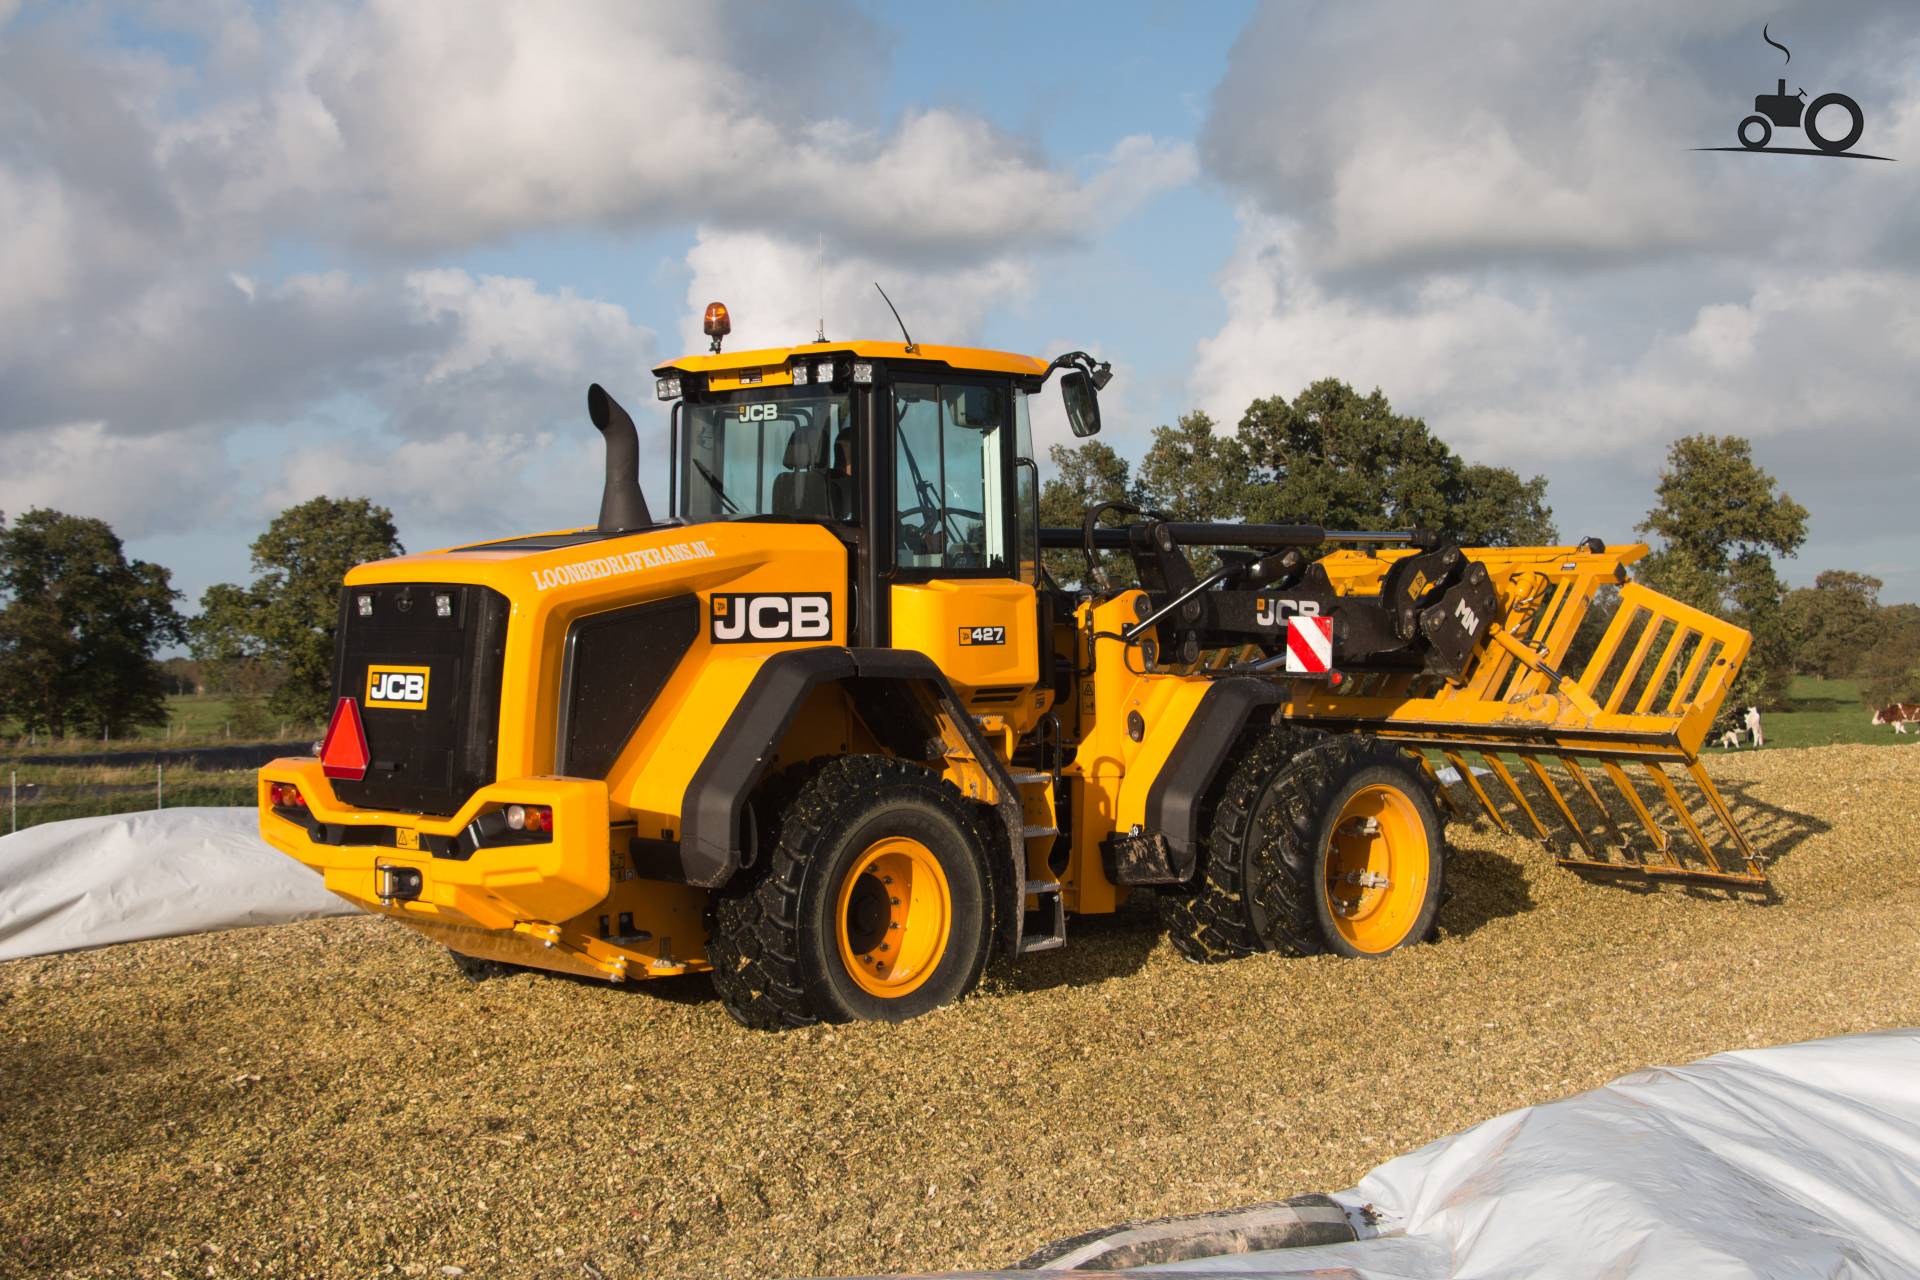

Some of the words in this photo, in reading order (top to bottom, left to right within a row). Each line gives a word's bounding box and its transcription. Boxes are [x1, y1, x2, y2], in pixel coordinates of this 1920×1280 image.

[739, 403, 778, 422] JCB
[531, 540, 716, 592] LOONBEDRIJFKRANS.NL
[714, 597, 830, 640] JCB
[972, 627, 1004, 641] 427
[371, 674, 424, 701] JCB
